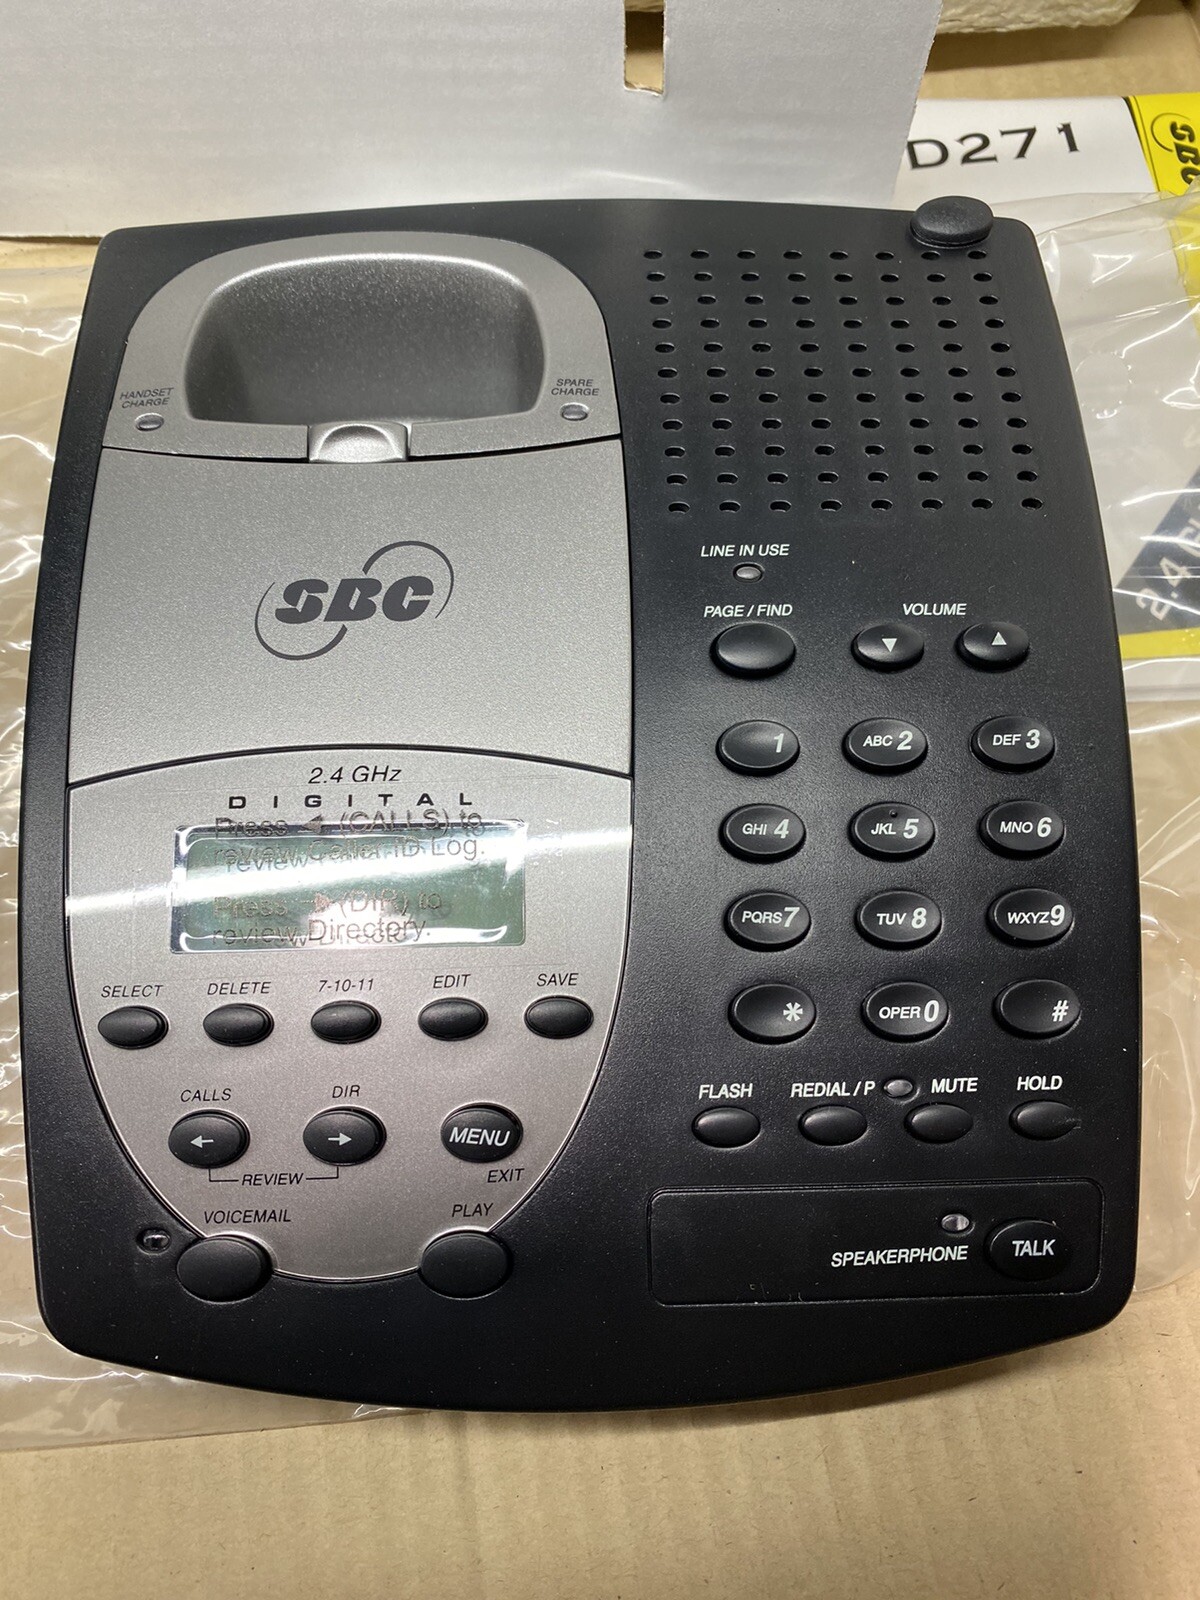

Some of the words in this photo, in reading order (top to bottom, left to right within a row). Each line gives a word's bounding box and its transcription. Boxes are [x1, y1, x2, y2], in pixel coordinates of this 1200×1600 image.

[906, 121, 1081, 171] D271
[556, 378, 594, 388] SPARE
[120, 386, 174, 400] HANDSET
[550, 386, 600, 397] CHARGE
[121, 397, 170, 409] CHARGE
[700, 544, 736, 558] LINE
[738, 544, 756, 557] IN
[758, 543, 790, 557] USE
[274, 575, 435, 624] SBC
[703, 604, 745, 618] PAGE
[756, 603, 793, 617] FIND
[902, 602, 967, 616] VOLUME
[773, 732, 785, 753] 1
[862, 734, 894, 748] ABC
[896, 730, 914, 751] 2
[992, 733, 1021, 747] DEF
[1025, 728, 1041, 750] 3
[308, 766, 344, 785] 2.4
[351, 765, 402, 784] GHz
[215, 816, 289, 838] Press
[459, 809, 482, 830] to
[741, 823, 768, 836] GHI
[773, 818, 790, 839] 4
[870, 823, 897, 836] JKL
[902, 818, 919, 839] 5
[999, 821, 1034, 834] MNO
[1036, 816, 1052, 838] 6
[214, 844, 298, 866] review
[394, 836, 421, 858] ID
[431, 836, 485, 861] Log.
[214, 896, 289, 919] Press
[1007, 911, 1050, 925] WXYZ
[1049, 904, 1065, 926] 9
[741, 910, 783, 925] PQRS
[783, 906, 800, 928] 7
[876, 912, 907, 926] TUV
[910, 907, 927, 929] 8
[212, 924, 299, 946] review
[206, 981, 272, 996] DELETE
[318, 978, 375, 993] 7-10-11
[432, 974, 471, 989] EDIT
[536, 973, 579, 988] SAVE
[100, 984, 163, 999] SELECT
[878, 1005, 921, 1020] OPER
[923, 1000, 940, 1023] 0
[698, 1083, 753, 1099] FLASH
[790, 1082, 851, 1098] REDIAL
[864, 1081, 876, 1096] P
[931, 1077, 979, 1093] MUTE
[1016, 1075, 1063, 1091] HOLD
[180, 1087, 232, 1103] CALLS
[331, 1084, 361, 1099] DIR
[448, 1127, 512, 1148] MENU
[241, 1172, 304, 1187] REVIEW
[486, 1168, 525, 1183] EXIT
[203, 1208, 292, 1224] VOICEMAIL
[452, 1203, 494, 1218] PLAY
[1011, 1239, 1056, 1257] TALK
[830, 1245, 969, 1268] SPEAKERPHONE
